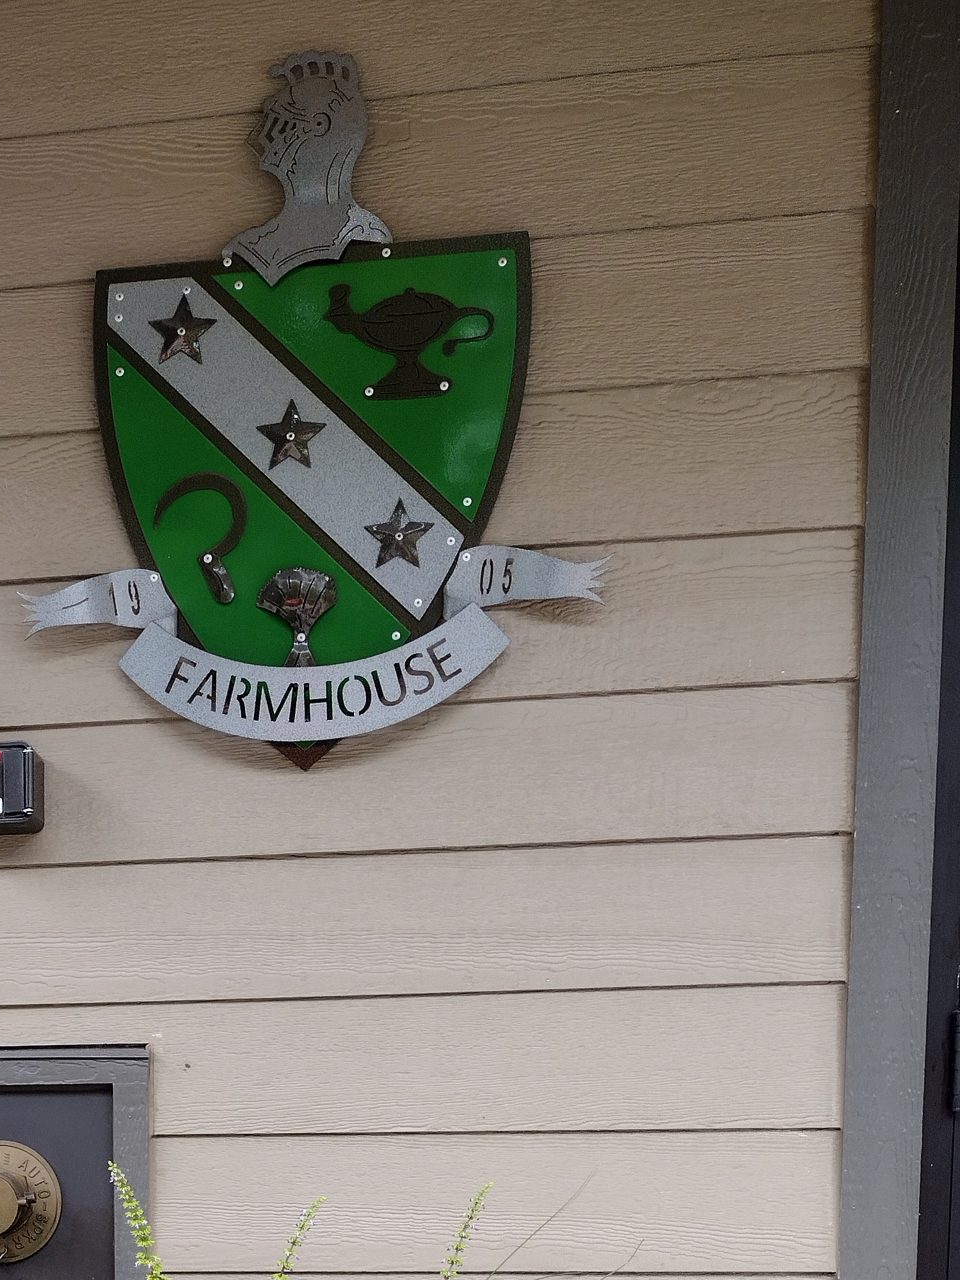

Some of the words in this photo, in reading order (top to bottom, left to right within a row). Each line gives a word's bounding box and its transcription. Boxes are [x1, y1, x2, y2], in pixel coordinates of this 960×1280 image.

[108, 580, 141, 616] 19
[480, 558, 514, 595] 05
[165, 637, 463, 723] FARMHOUSE
[11, 1158, 52, 1251] AUTO-SPKR
